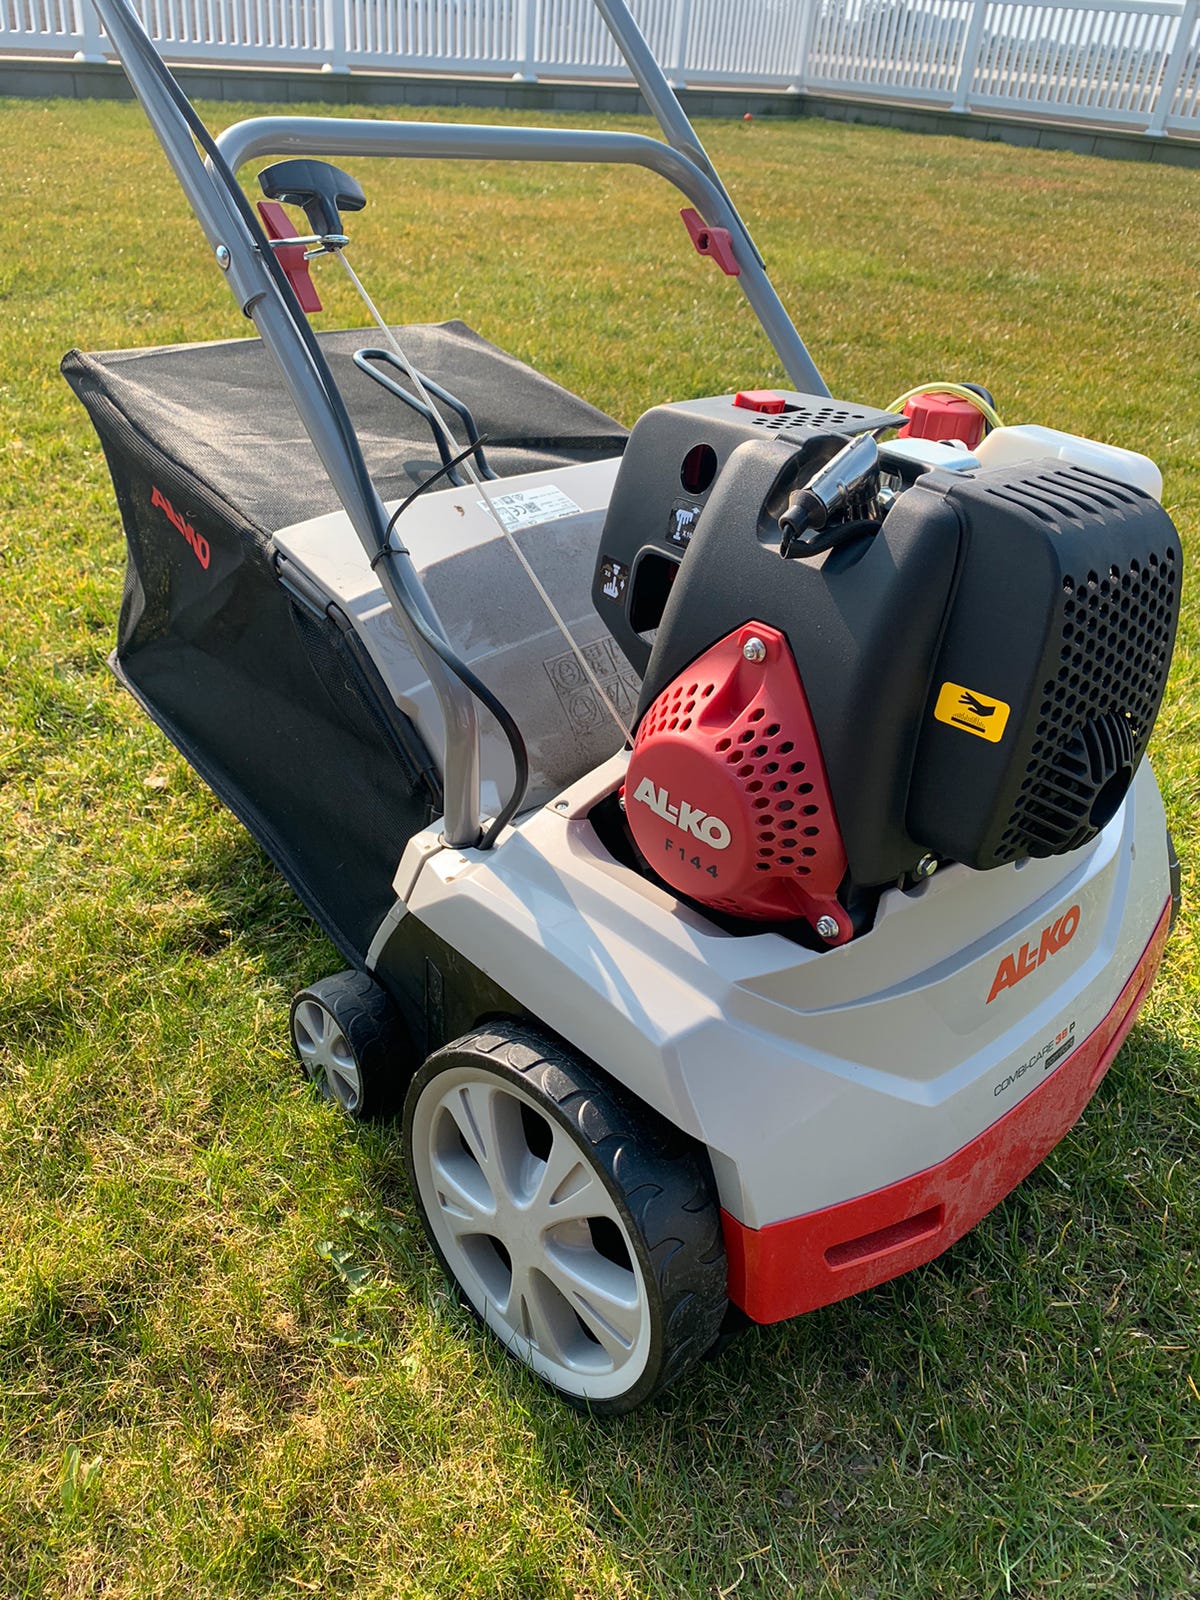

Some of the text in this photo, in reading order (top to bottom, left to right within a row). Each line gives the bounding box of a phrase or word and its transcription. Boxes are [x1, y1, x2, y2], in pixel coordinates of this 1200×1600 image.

[633, 776, 731, 850] AL-KO
[986, 904, 1081, 1005] AL-KO
[994, 1039, 1055, 1097] COMBI-CARE
[1069, 1021, 1076, 1034] P
